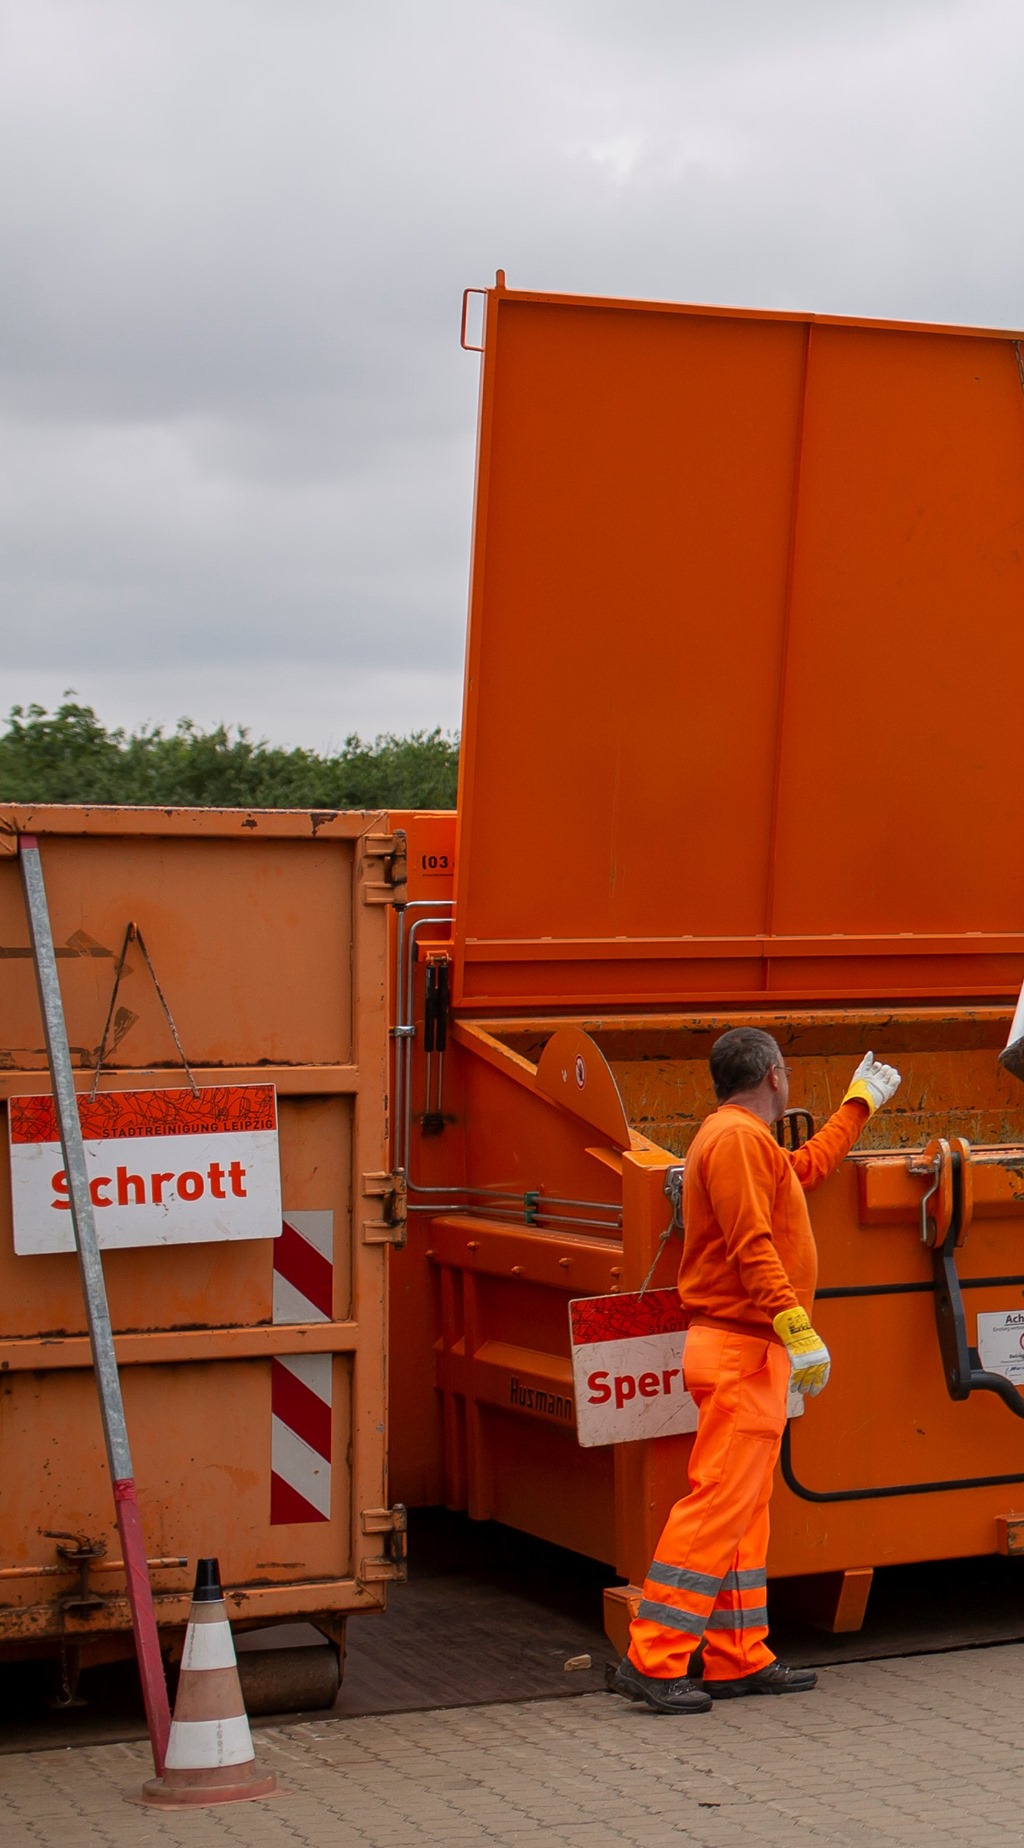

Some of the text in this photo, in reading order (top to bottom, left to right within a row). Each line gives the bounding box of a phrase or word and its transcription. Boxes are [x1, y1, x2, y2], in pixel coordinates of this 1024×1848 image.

[102, 1119, 274, 1138] STADTREINIGUNG LEIPZIG
[51, 1161, 247, 1210] Schrott
[510, 1376, 572, 1419] Husmann
